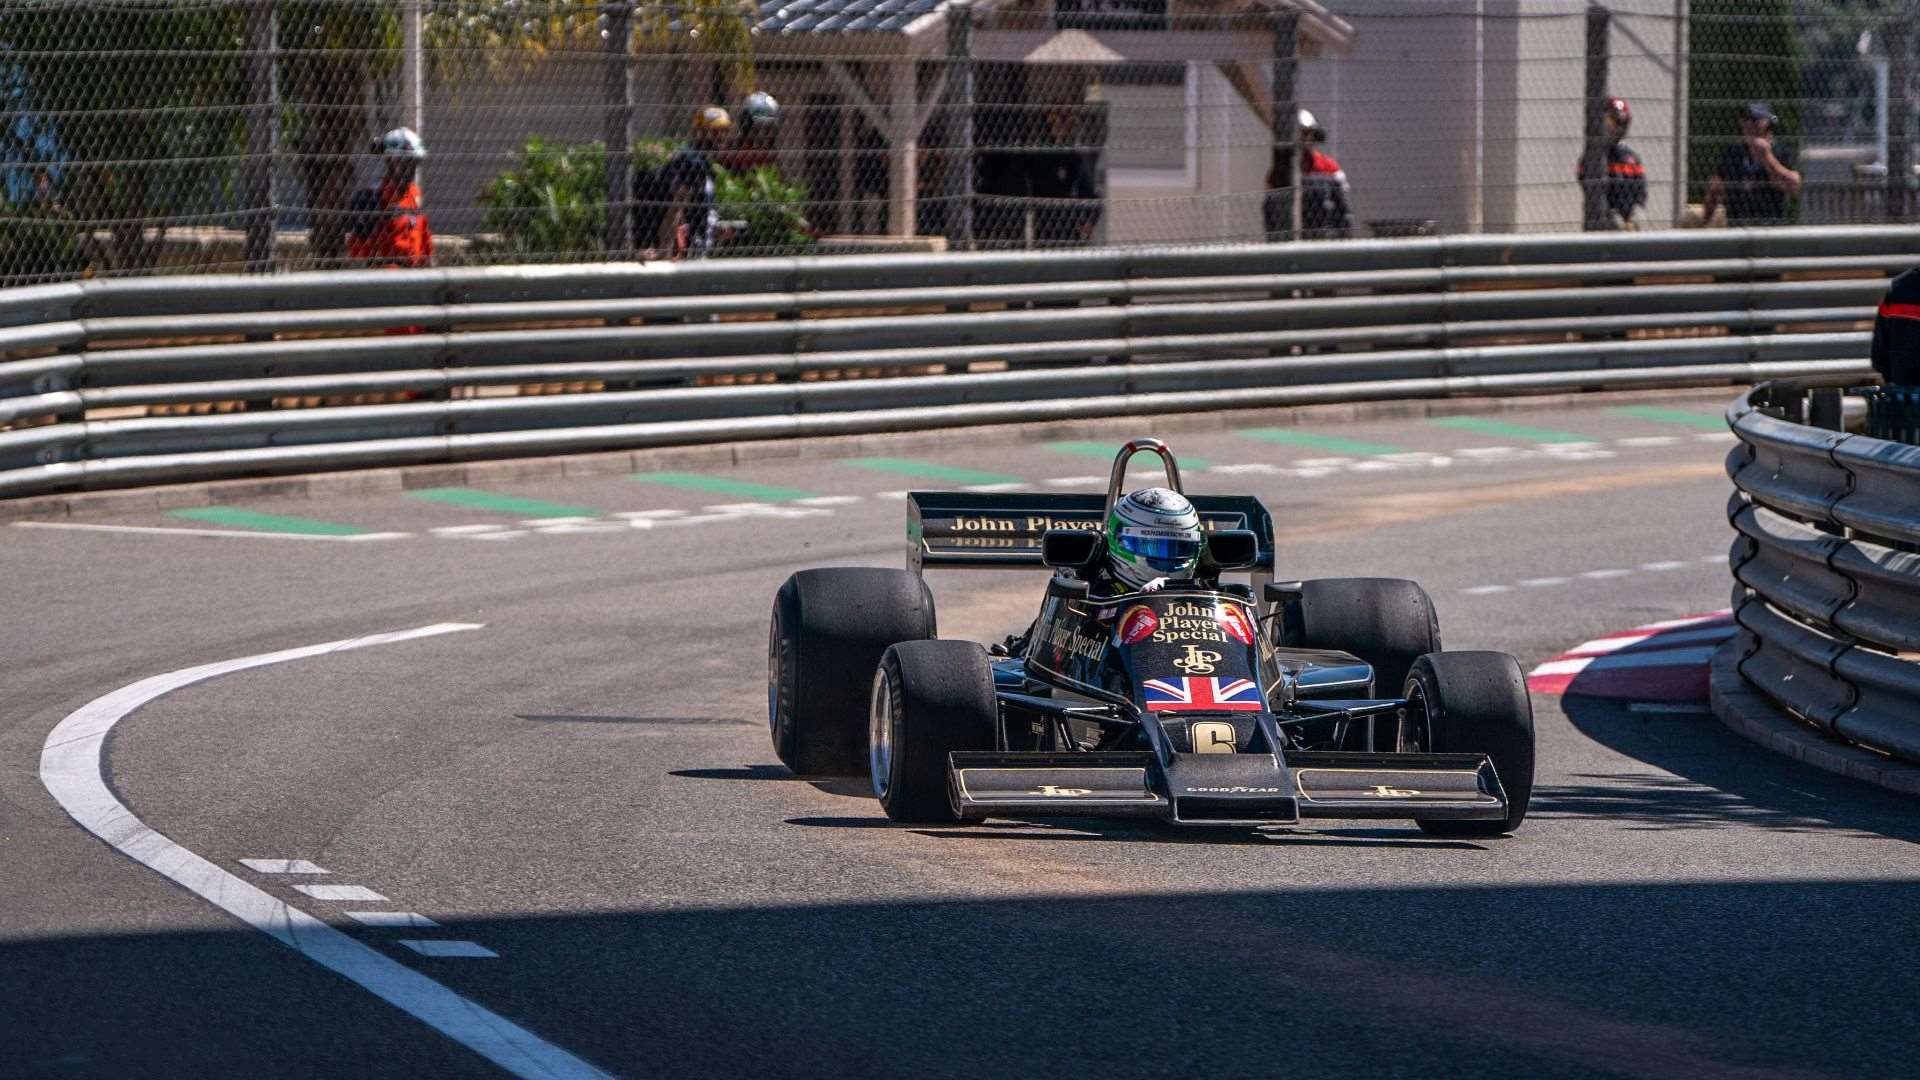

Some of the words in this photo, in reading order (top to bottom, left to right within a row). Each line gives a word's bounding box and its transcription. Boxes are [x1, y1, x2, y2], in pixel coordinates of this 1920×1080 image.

[950, 515, 1016, 532] John
[1163, 602, 1216, 619] John
[1158, 616, 1221, 632] Player
[1068, 625, 1109, 662] Special
[1153, 629, 1229, 644] Special
[1186, 786, 1280, 794] GOODYEAR
